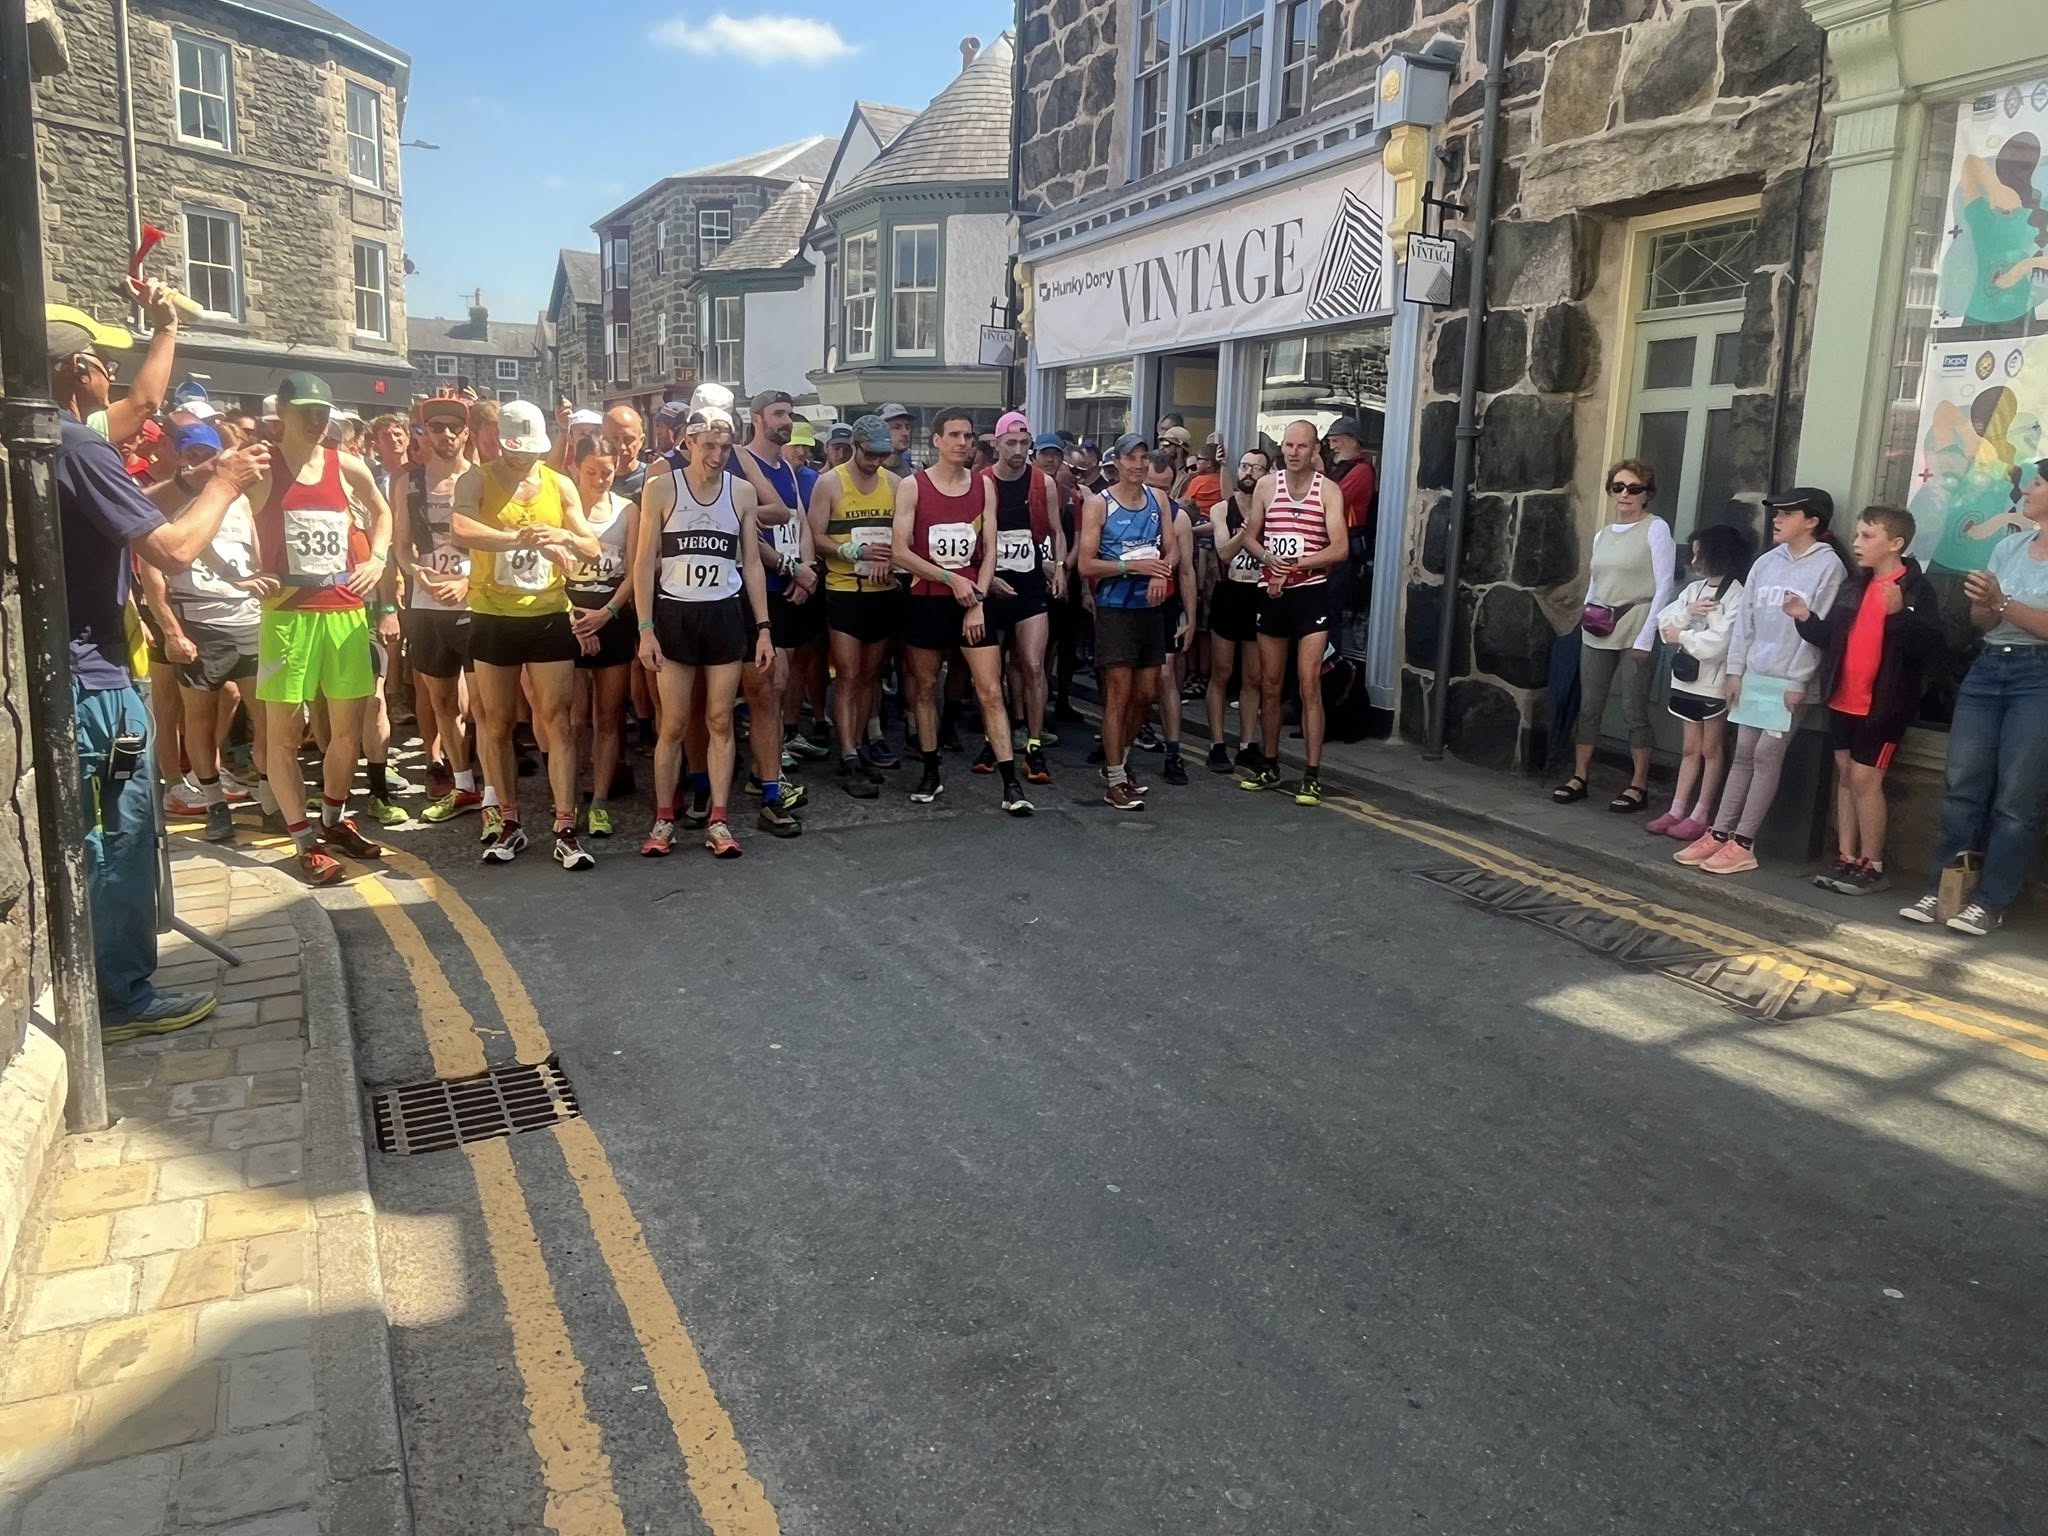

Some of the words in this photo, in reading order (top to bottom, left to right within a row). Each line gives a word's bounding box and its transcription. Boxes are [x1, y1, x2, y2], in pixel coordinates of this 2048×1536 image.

[1411, 244, 1454, 264] VINTAGE
[1053, 276, 1084, 298] Hunky
[1085, 269, 1114, 289] Dory
[1118, 218, 1304, 327] VINTAGE
[845, 509, 880, 519] KESWICK
[296, 530, 341, 556] 338
[936, 538, 969, 557] 313
[1003, 543, 1030, 560] 170
[1272, 537, 1297, 556] 303
[432, 552, 463, 576] 123
[685, 563, 720, 588] 192
